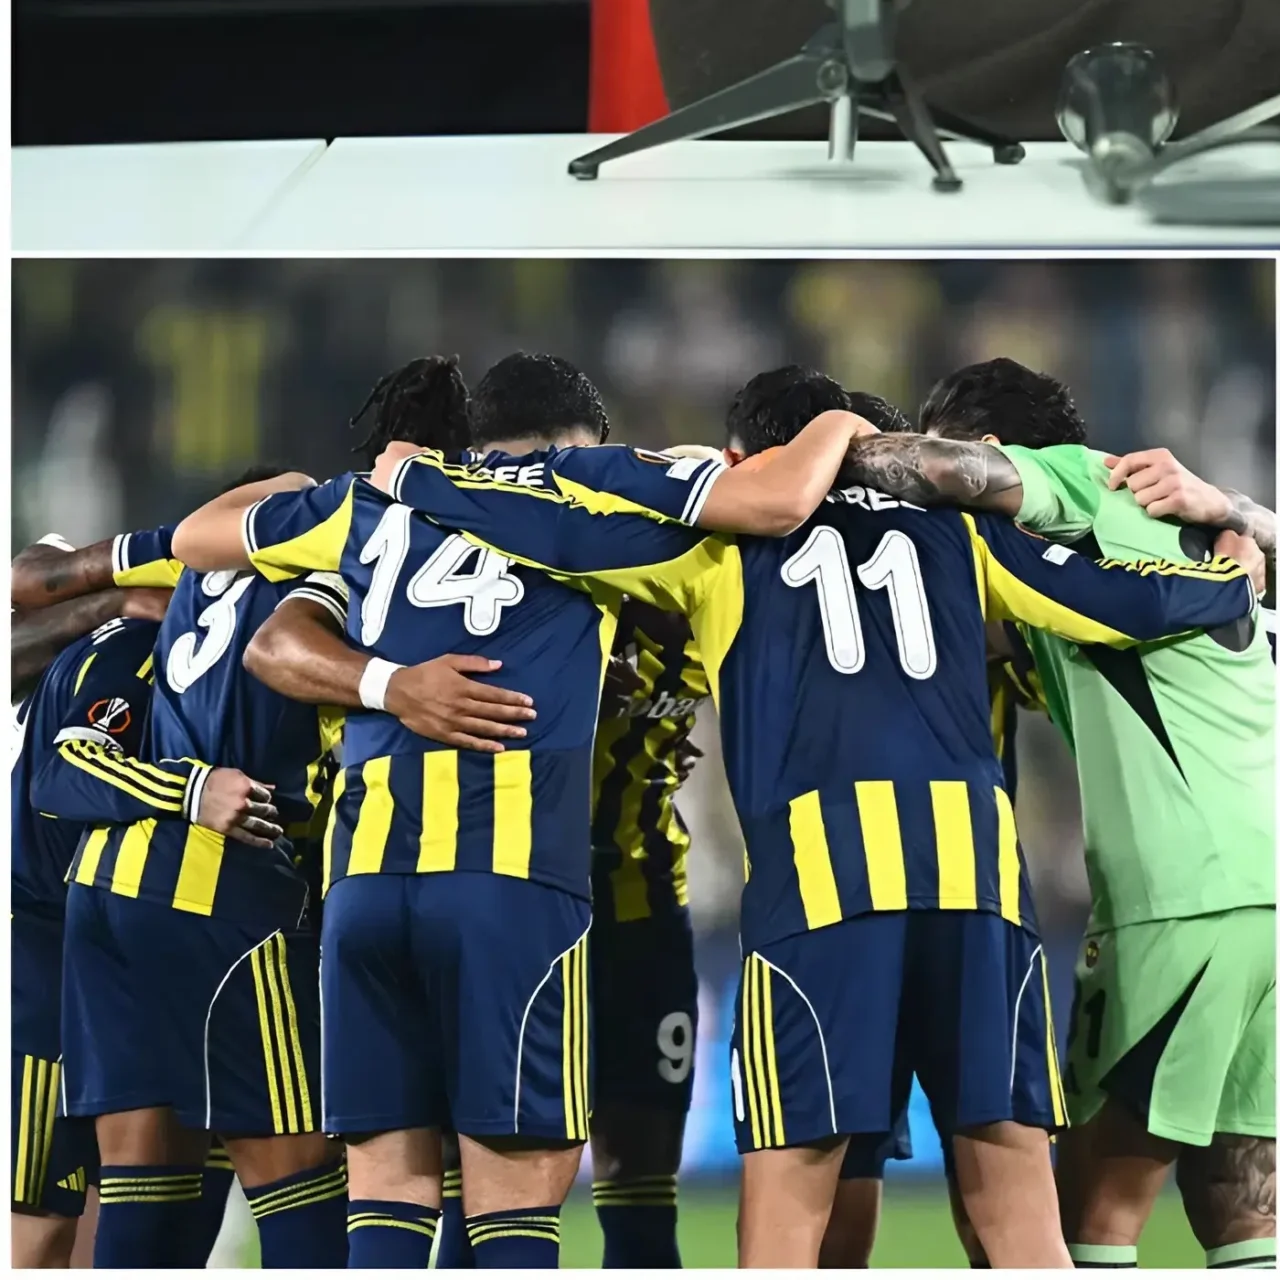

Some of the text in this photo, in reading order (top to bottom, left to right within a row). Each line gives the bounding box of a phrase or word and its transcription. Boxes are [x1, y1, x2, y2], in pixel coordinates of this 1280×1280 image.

[359, 503, 525, 646] 14
[781, 525, 937, 680] 11
[657, 1011, 693, 1083] 9
